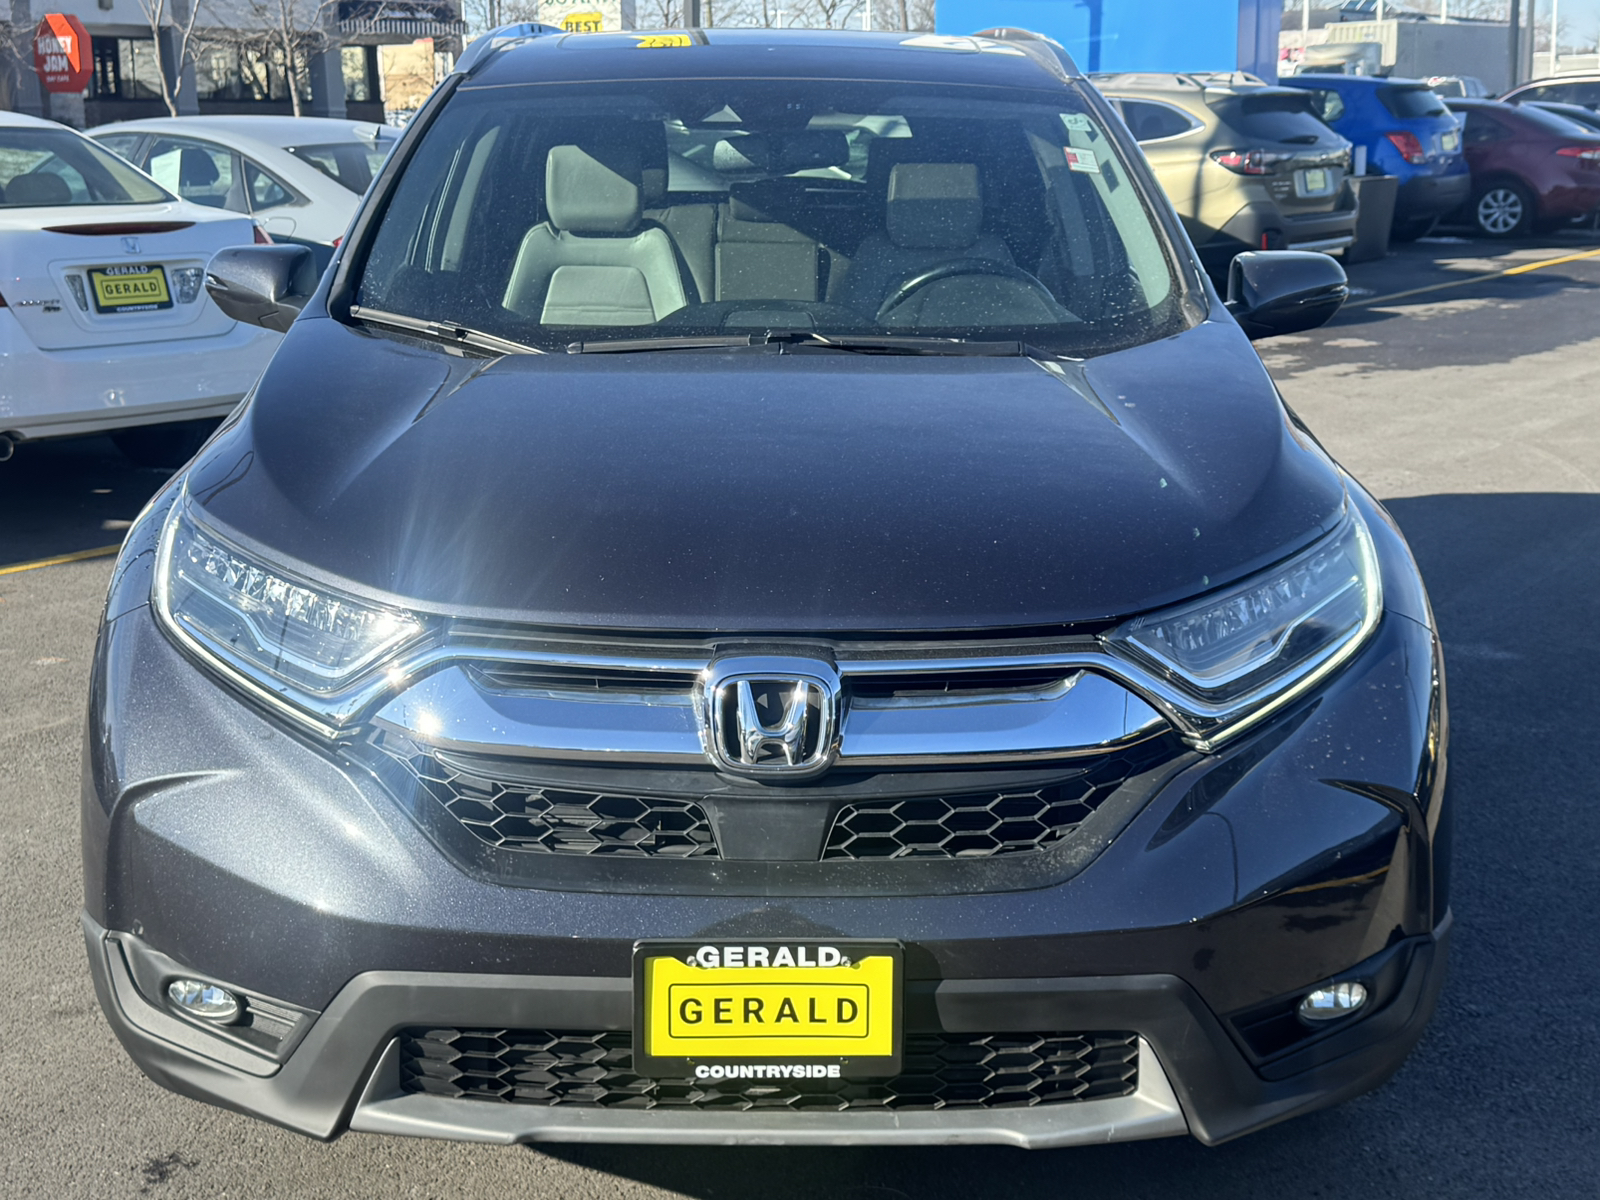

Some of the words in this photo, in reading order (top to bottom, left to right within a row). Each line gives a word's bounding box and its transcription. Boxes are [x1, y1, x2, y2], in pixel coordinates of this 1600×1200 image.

[565, 21, 600, 33] BEST
[43, 55, 69, 73] JAM
[106, 265, 149, 276] GERALD
[105, 282, 157, 295] GERALD
[695, 945, 842, 968] GERALD
[679, 997, 859, 1025] GERALD
[695, 1064, 841, 1079] COUNTRYSIDE
